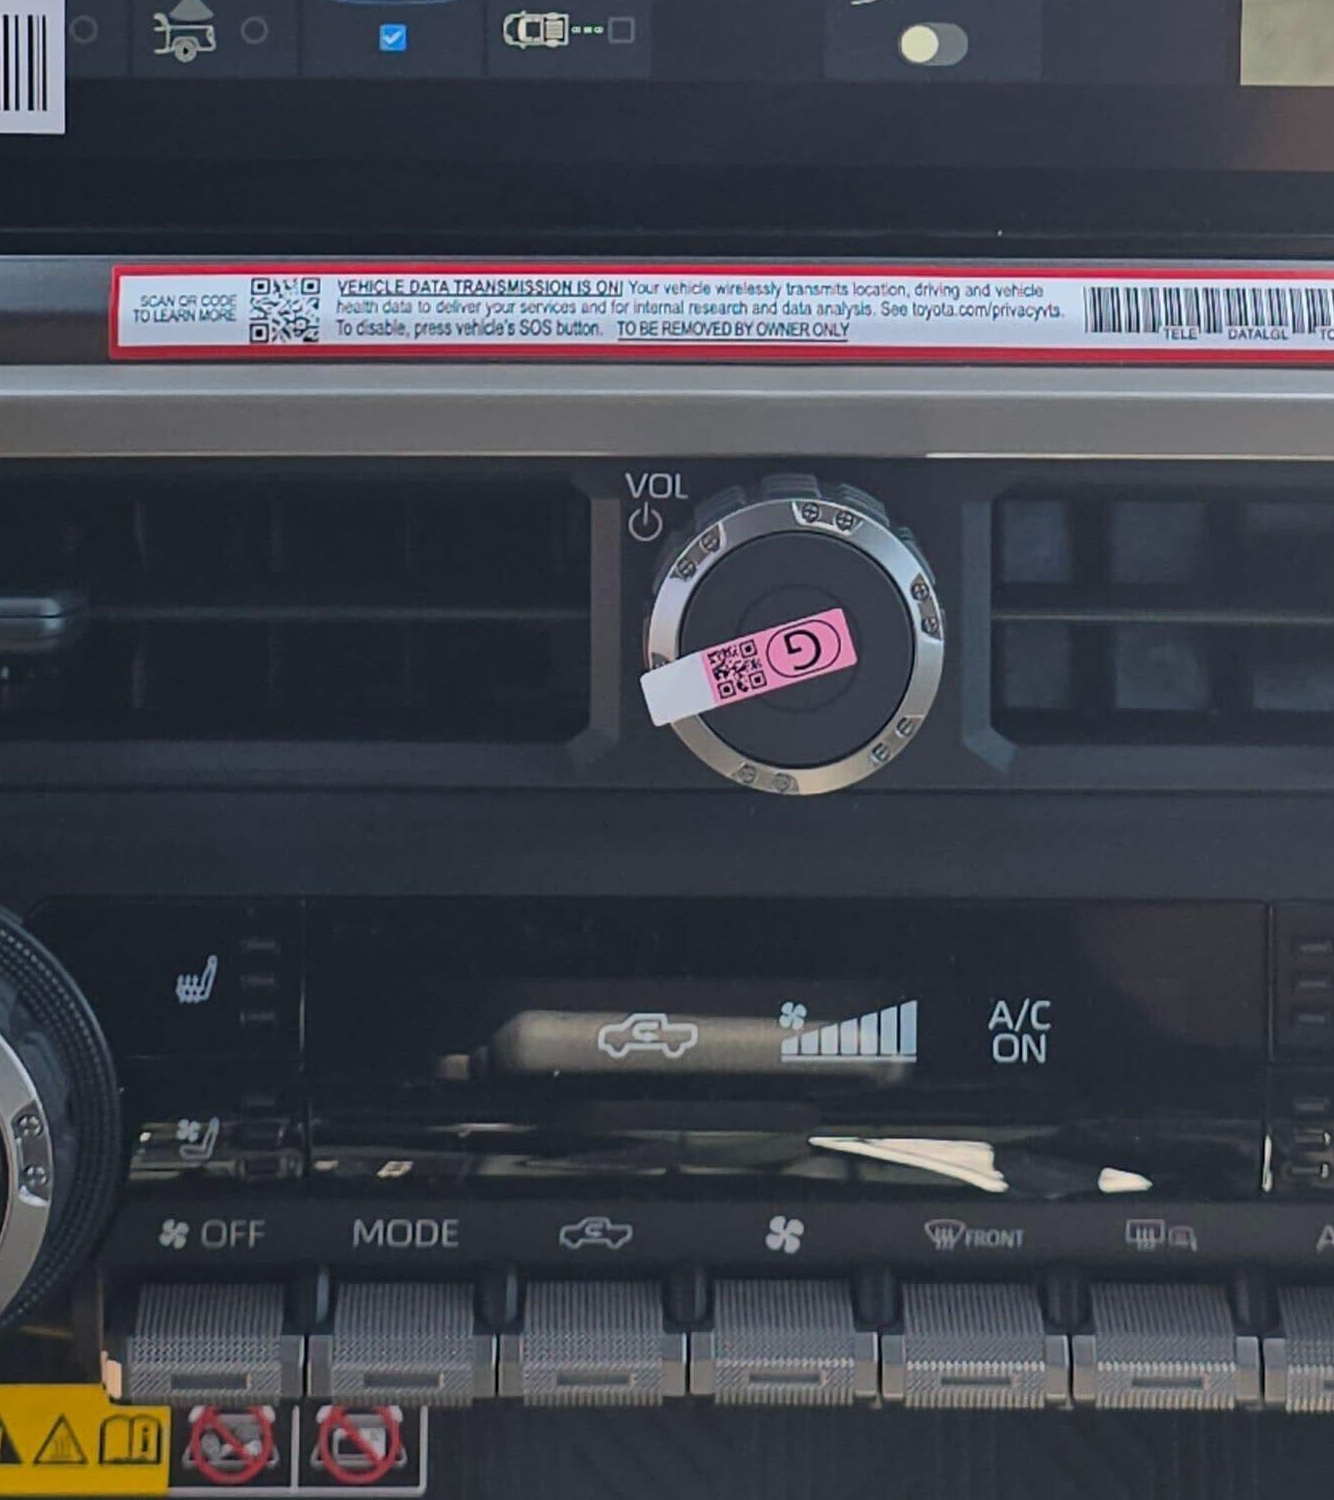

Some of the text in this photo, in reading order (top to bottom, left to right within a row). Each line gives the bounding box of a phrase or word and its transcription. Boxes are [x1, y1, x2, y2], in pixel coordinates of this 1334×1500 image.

[337, 279, 409, 294] VEHICLE
[410, 279, 449, 294] DATA
[454, 279, 572, 294] TRANSMISSION
[577, 280, 591, 294] IS
[628, 280, 658, 295] Your
[664, 281, 711, 296] vehicle
[717, 281, 781, 299] wirelessly
[786, 282, 848, 297] transmits
[853, 282, 910, 298] location,
[915, 282, 960, 300] driving
[966, 283, 990, 297] and
[995, 283, 1043, 298] vehicle
[140, 294, 174, 307] SCAN
[201, 294, 237, 307] CODE
[336, 300, 378, 313] health
[382, 300, 412, 313] data
[418, 300, 431, 313] to
[436, 300, 480, 313] deliver
[485, 302, 515, 317] your
[520, 300, 576, 314] services
[582, 300, 606, 314] and
[611, 300, 628, 314] for
[634, 301, 684, 315] internal
[689, 301, 747, 315] research
[752, 301, 777, 315] and
[782, 301, 812, 315] data
[881, 302, 907, 316] See
[133, 309, 237, 322] TO LEARN MORE
[336, 319, 850, 340] To disable, press vehicle's SOS button. TO BE REMOVED BY OWNER ONLY
[1163, 328, 1197, 340] TELE
[625, 473, 689, 500] VOL
[988, 1000, 1052, 1031] A/C
[992, 1033, 1047, 1063] ON
[200, 1218, 266, 1248] OFF
[352, 1218, 460, 1248] MODE
[966, 1229, 1024, 1248] FRONT
